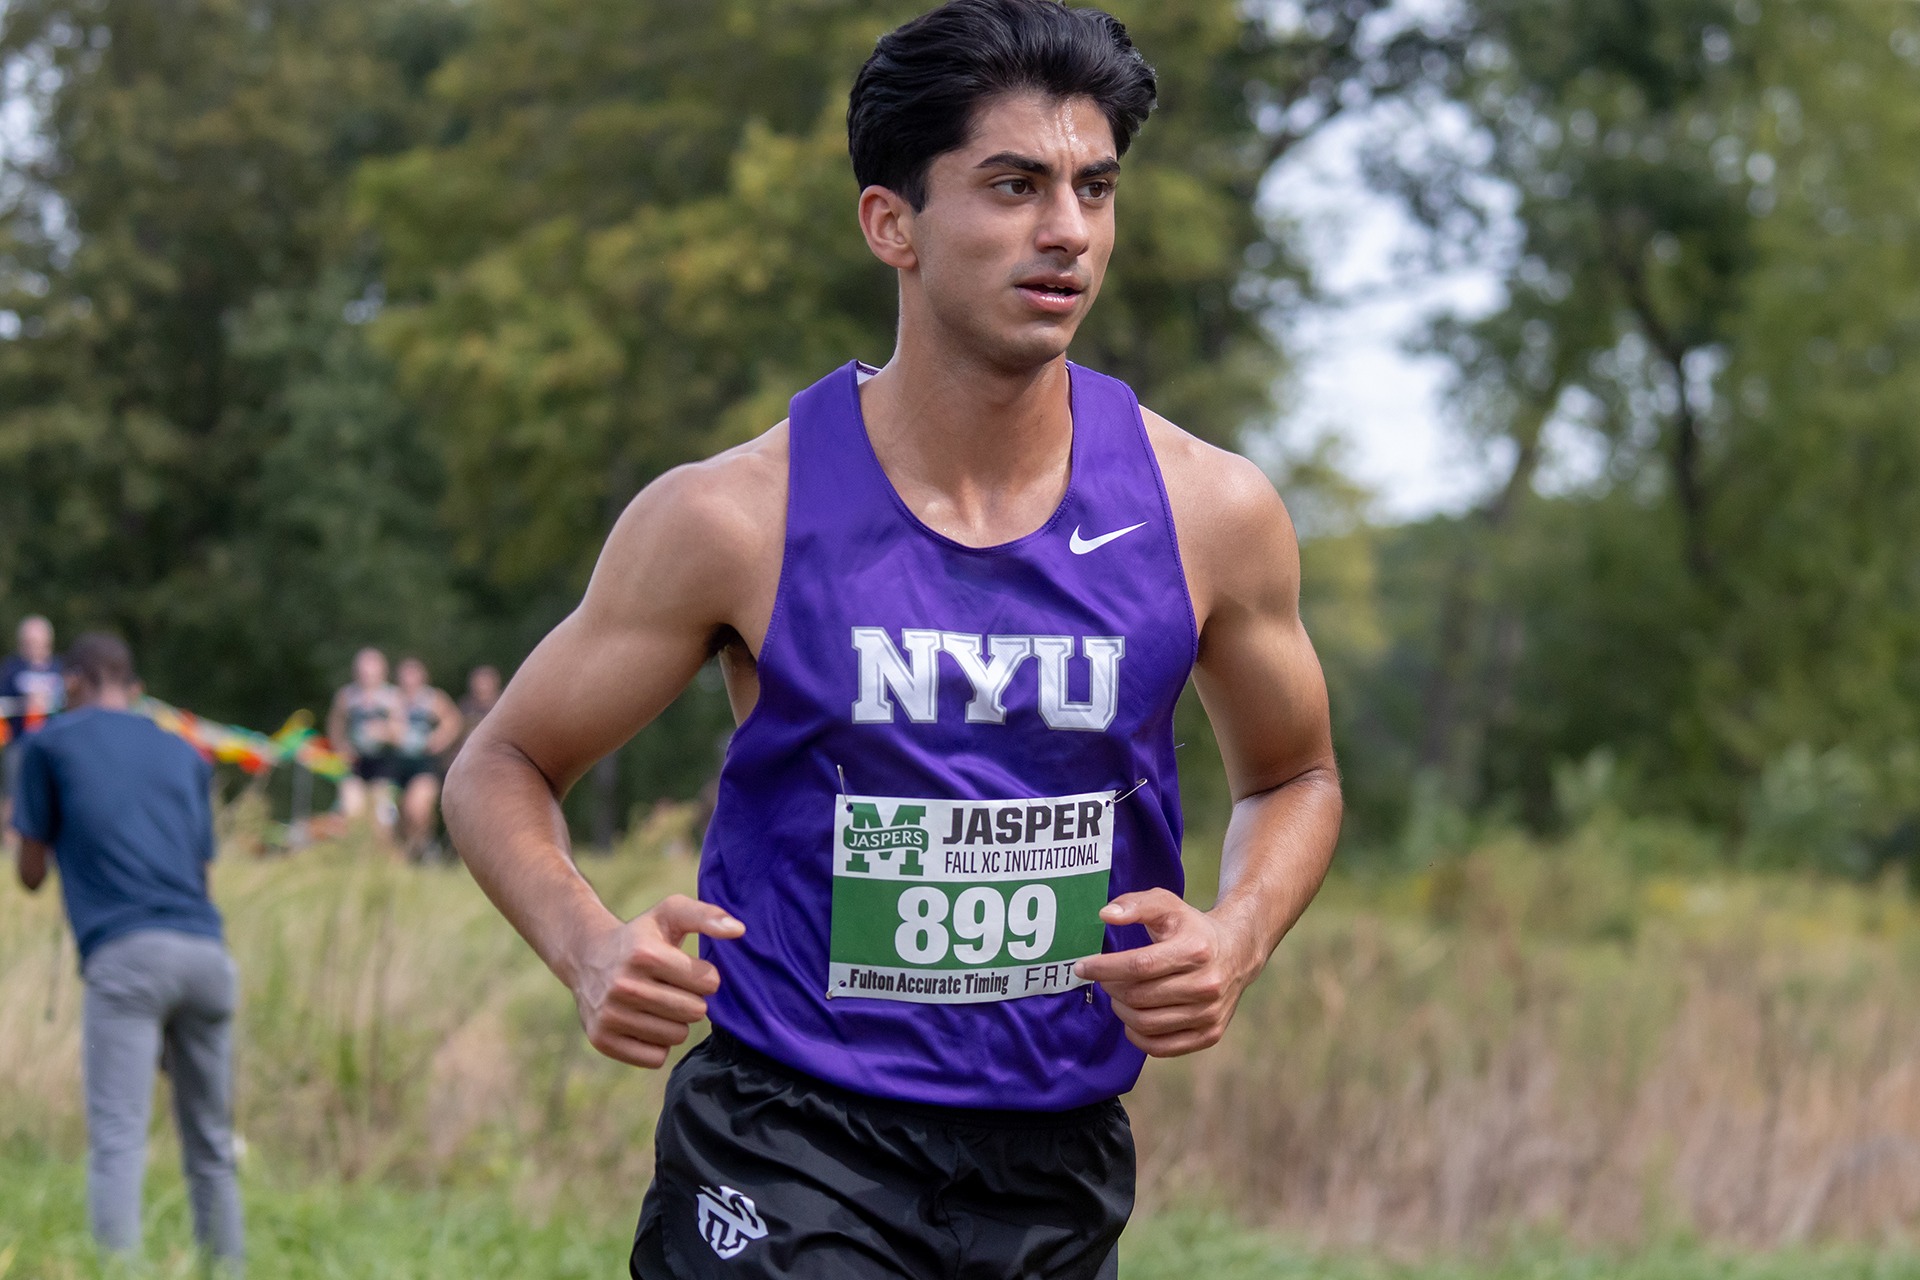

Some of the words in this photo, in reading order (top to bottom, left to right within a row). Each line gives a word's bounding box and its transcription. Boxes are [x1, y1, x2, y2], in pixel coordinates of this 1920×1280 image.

[851, 626, 1125, 732] NYU
[849, 830, 923, 848] JASPERS
[942, 800, 1103, 845] JASPER
[945, 851, 977, 873] FALL
[981, 851, 1000, 873] XC
[1003, 842, 1099, 873] INVITATIONAL
[895, 884, 1057, 965] 899
[849, 968, 894, 992] Fulton
[896, 973, 961, 995] Accurate
[964, 972, 1010, 995] Timing
[1024, 961, 1077, 991] FAT
